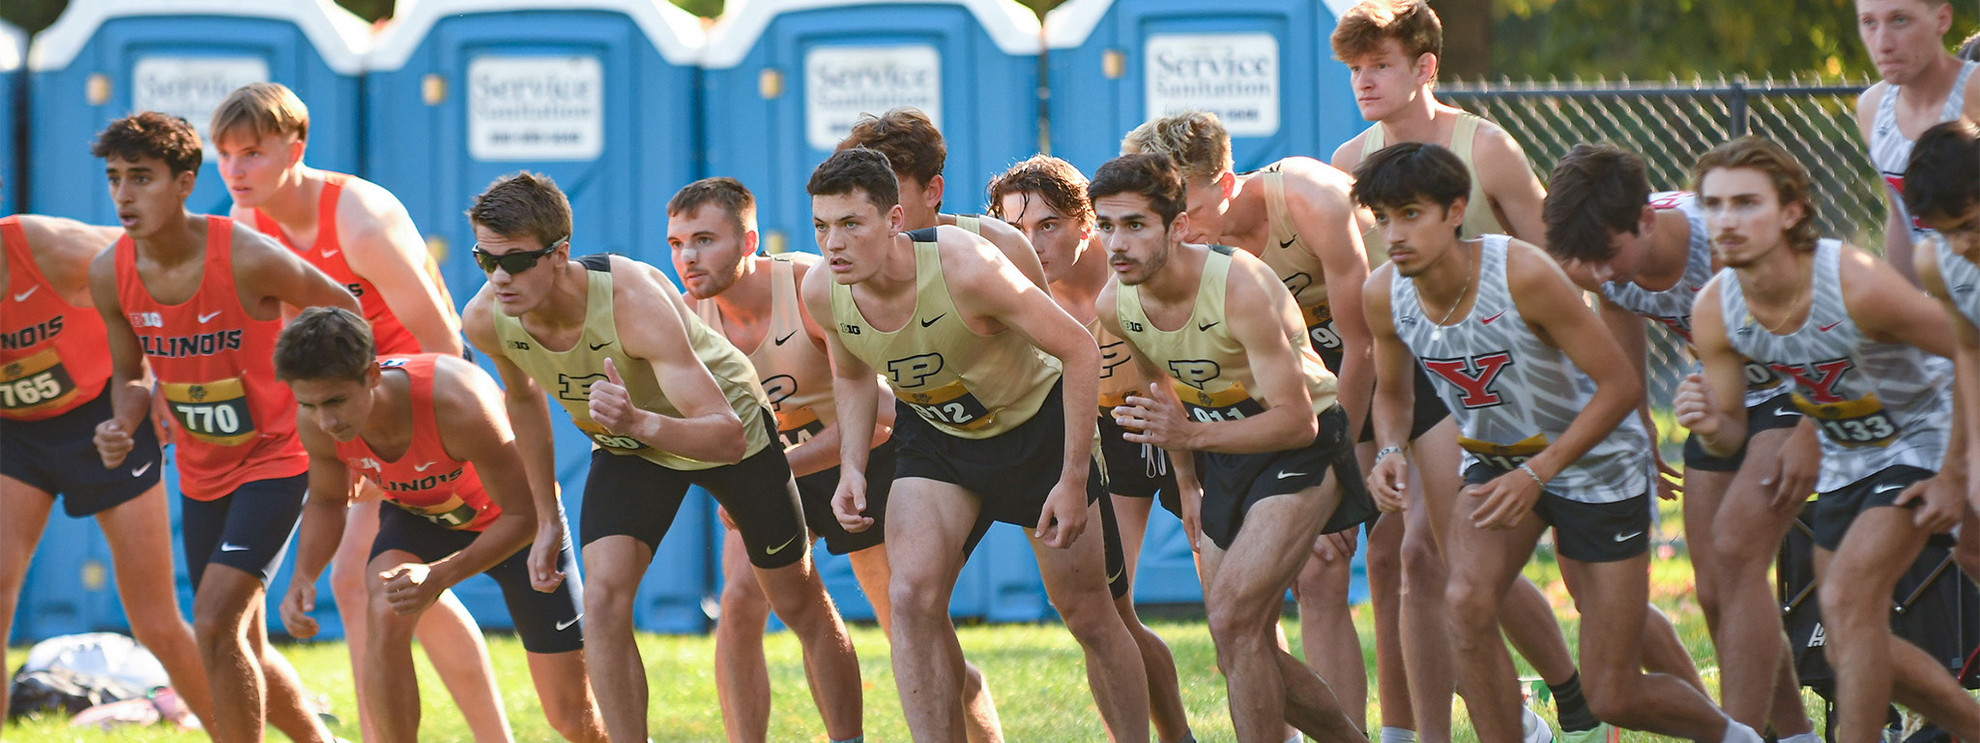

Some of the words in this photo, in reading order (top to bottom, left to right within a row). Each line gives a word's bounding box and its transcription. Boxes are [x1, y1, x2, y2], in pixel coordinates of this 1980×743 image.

[1157, 48, 1270, 76] Service
[141, 329, 243, 358] LLINOIS
[888, 352, 944, 388] P
[1168, 359, 1220, 390] P
[1420, 350, 1515, 409] Y
[1766, 357, 1855, 405] Y
[0, 372, 62, 407] 765
[176, 404, 240, 434] 770
[1823, 415, 1895, 441] 133
